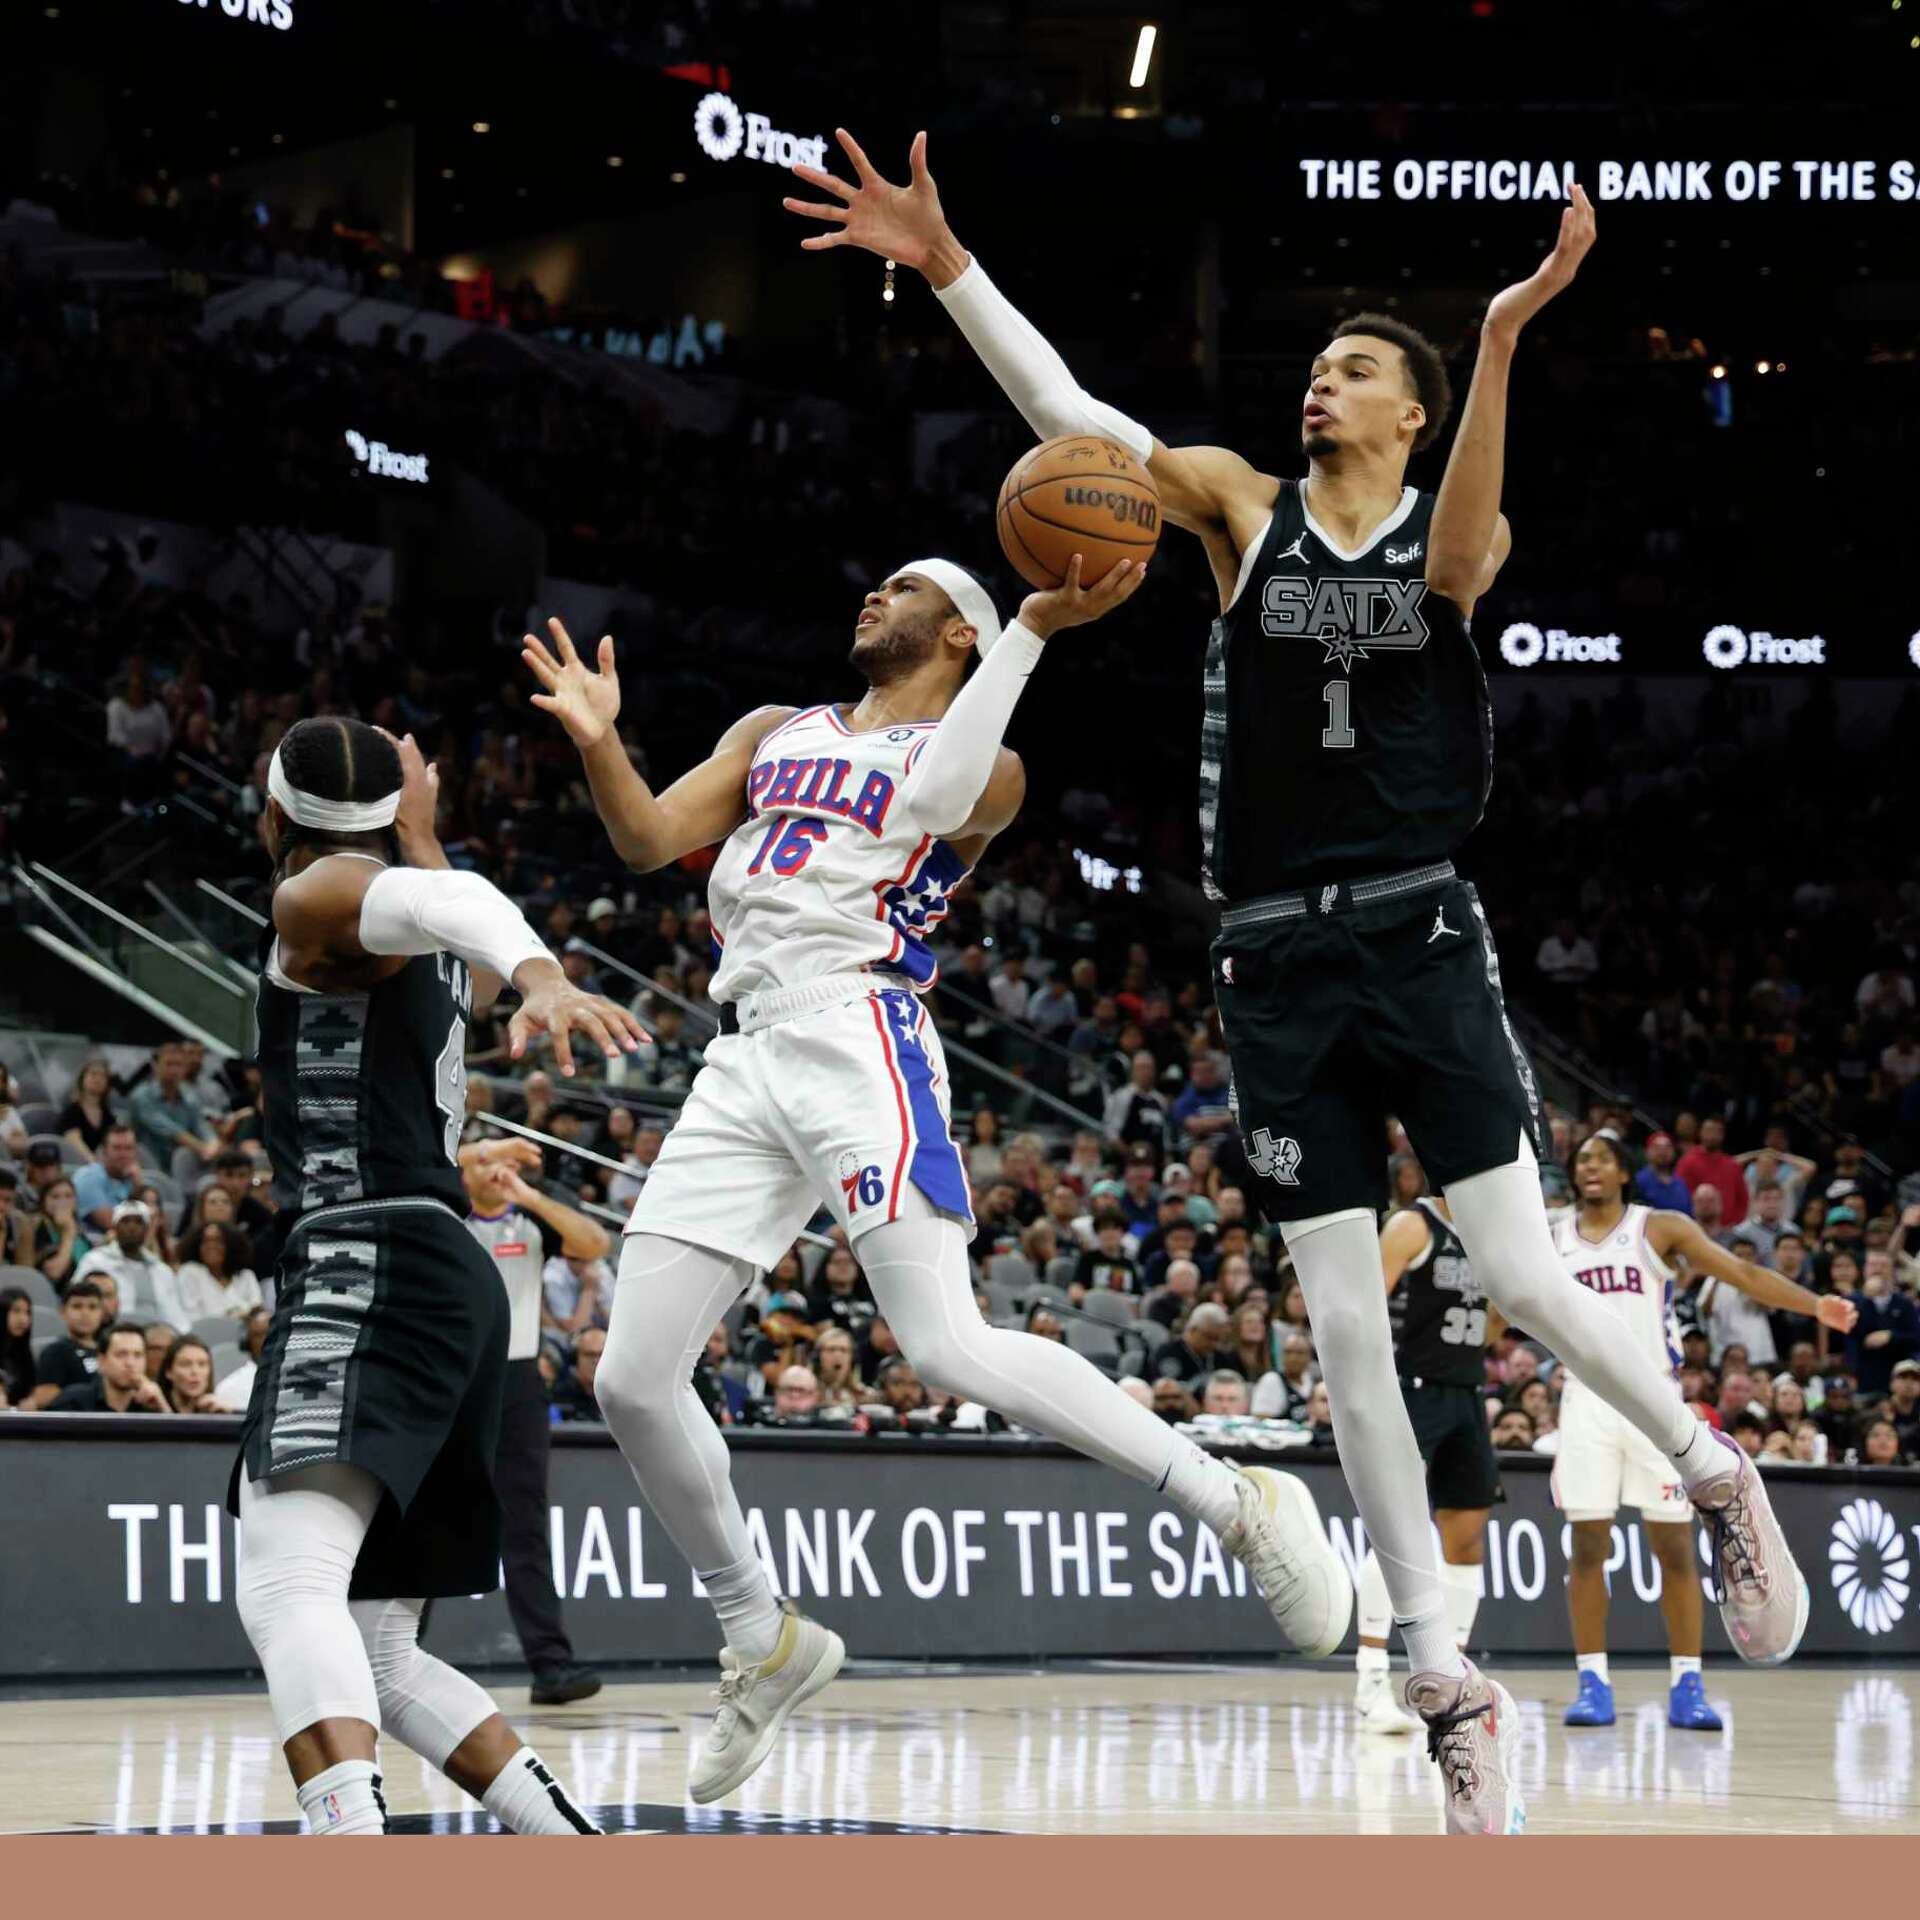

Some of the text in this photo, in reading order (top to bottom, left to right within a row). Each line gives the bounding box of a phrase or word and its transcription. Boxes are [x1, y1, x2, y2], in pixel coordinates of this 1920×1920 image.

[744, 112, 828, 174] Frost
[1300, 159, 1381, 200] THE
[1598, 160, 1713, 200] BANK
[1724, 160, 1782, 201] OF
[1792, 160, 1876, 200] THE
[1888, 160, 1920, 201] S
[368, 440, 429, 483] Frost
[1064, 487, 1157, 532] Wilson
[1261, 576, 1430, 650] SATX
[1545, 629, 1622, 662] Frost
[1748, 631, 1826, 664] Frost
[1323, 680, 1355, 748] 1
[751, 757, 895, 839] PHILA
[747, 814, 829, 877] 16
[840, 1164, 885, 1215] 76
[107, 1504, 241, 1603] TH
[692, 1508, 882, 1598] ANK
[901, 1507, 986, 1599] OF
[1004, 1510, 1132, 1597] THE
[1148, 1511, 1264, 1598] SA
